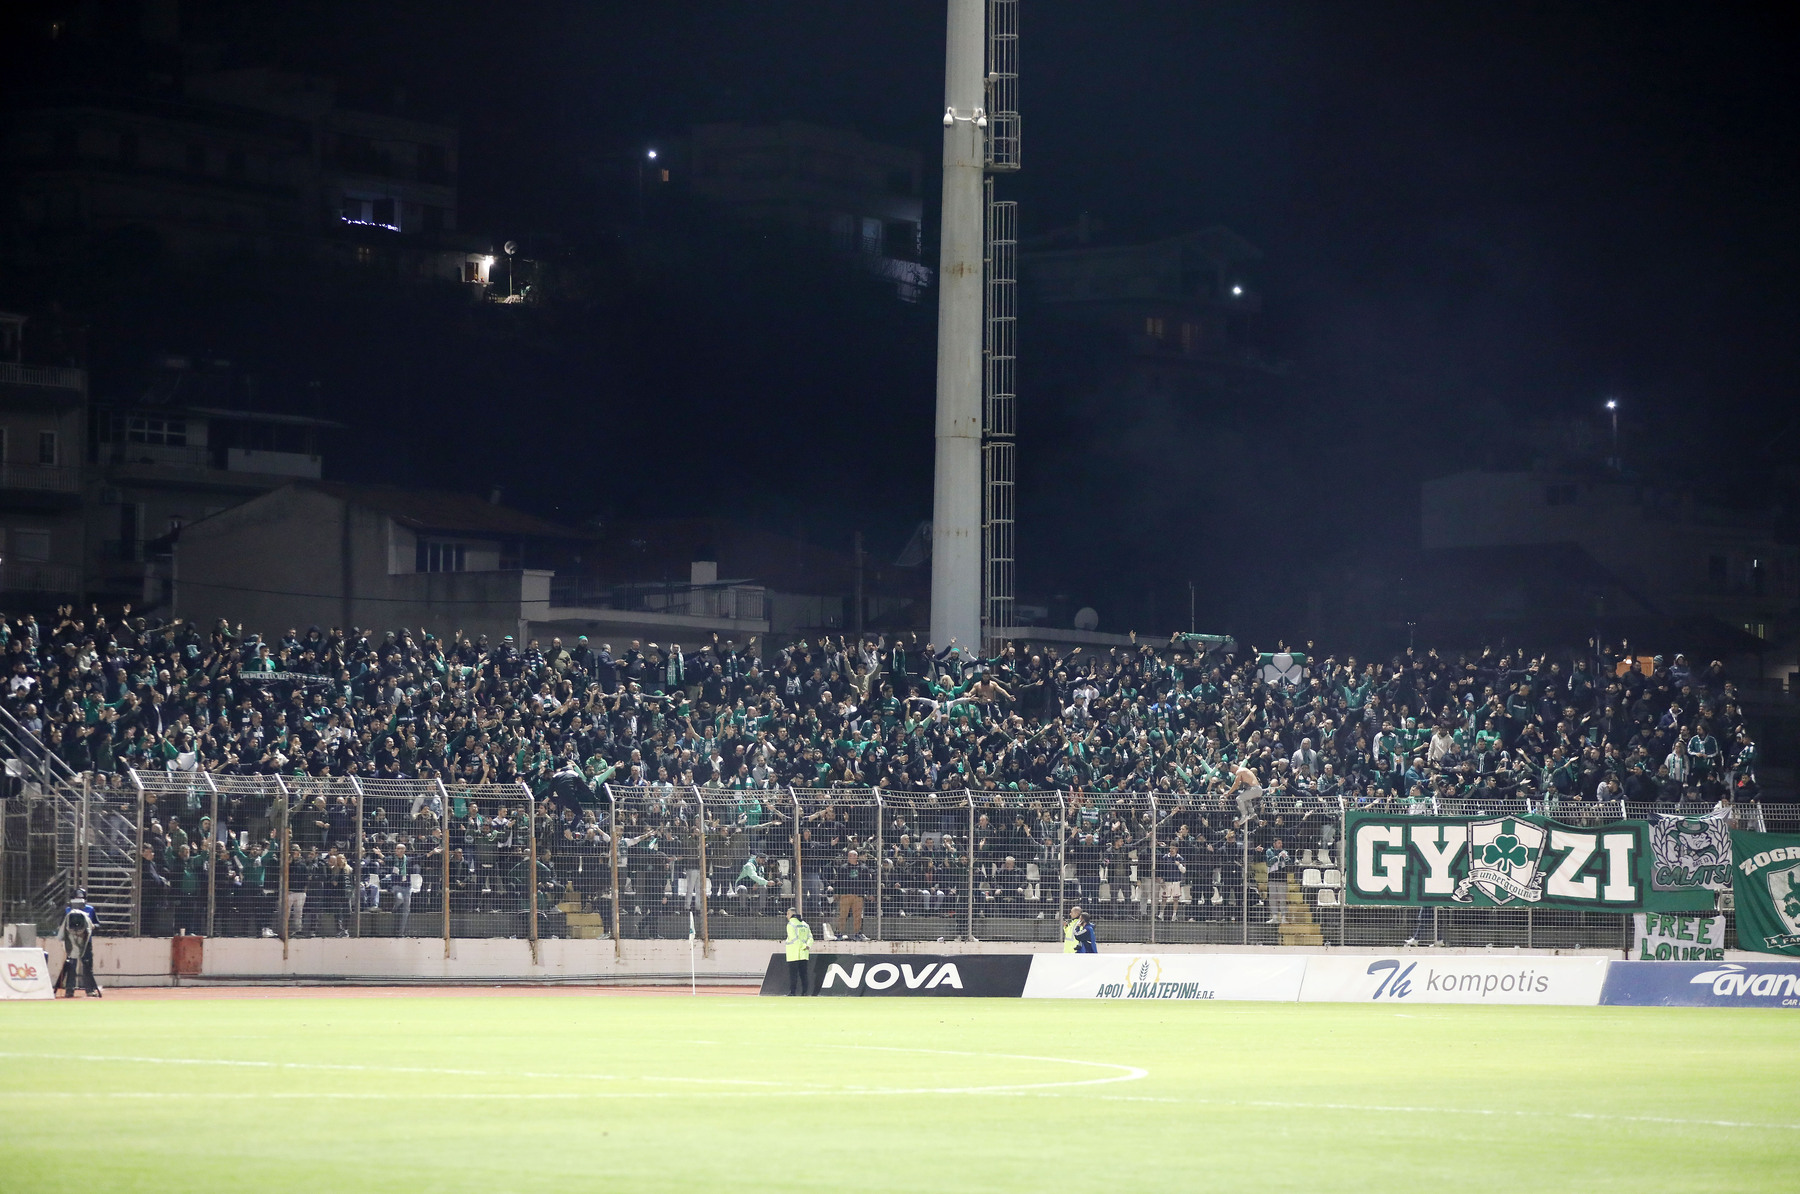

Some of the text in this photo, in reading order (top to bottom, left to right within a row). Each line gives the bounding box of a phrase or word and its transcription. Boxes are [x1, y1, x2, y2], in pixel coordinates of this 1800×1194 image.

[1646, 913, 1715, 944] FREE
[1640, 937, 1725, 961] LOUKAS
[8, 963, 37, 978] Dole
[821, 962, 964, 990] NOVA
[1426, 969, 1549, 997] kompotis
